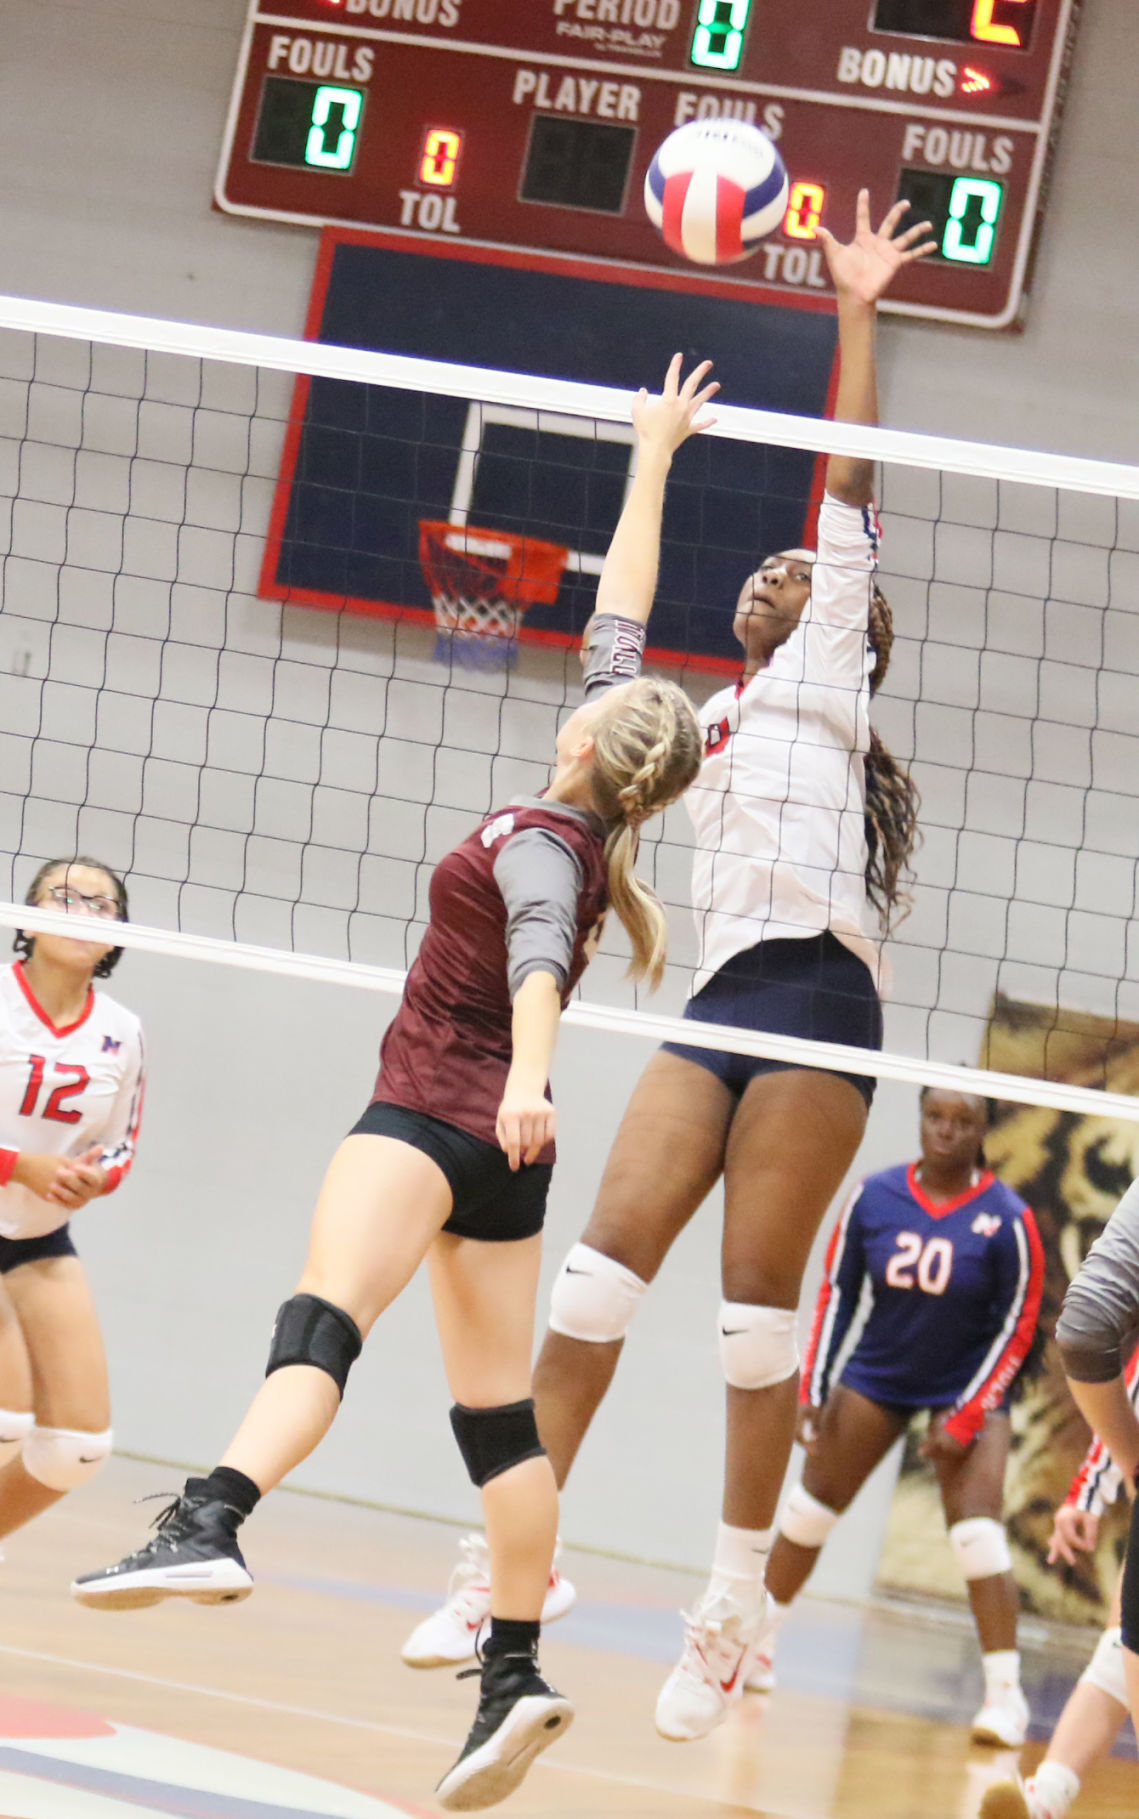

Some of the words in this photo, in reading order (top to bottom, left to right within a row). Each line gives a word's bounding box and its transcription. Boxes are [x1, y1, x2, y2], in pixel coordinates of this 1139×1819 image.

[266, 35, 375, 82] FOULS
[837, 46, 957, 98] BONUS
[512, 69, 641, 121] PLAYER
[304, 86, 363, 170] 0
[901, 123, 1014, 173] FOULS
[420, 128, 461, 187] 0
[399, 190, 461, 233] TOL
[942, 176, 1002, 265] 0
[763, 242, 826, 288] TOL
[19, 1054, 90, 1124] 12
[885, 1231, 953, 1296] 20
